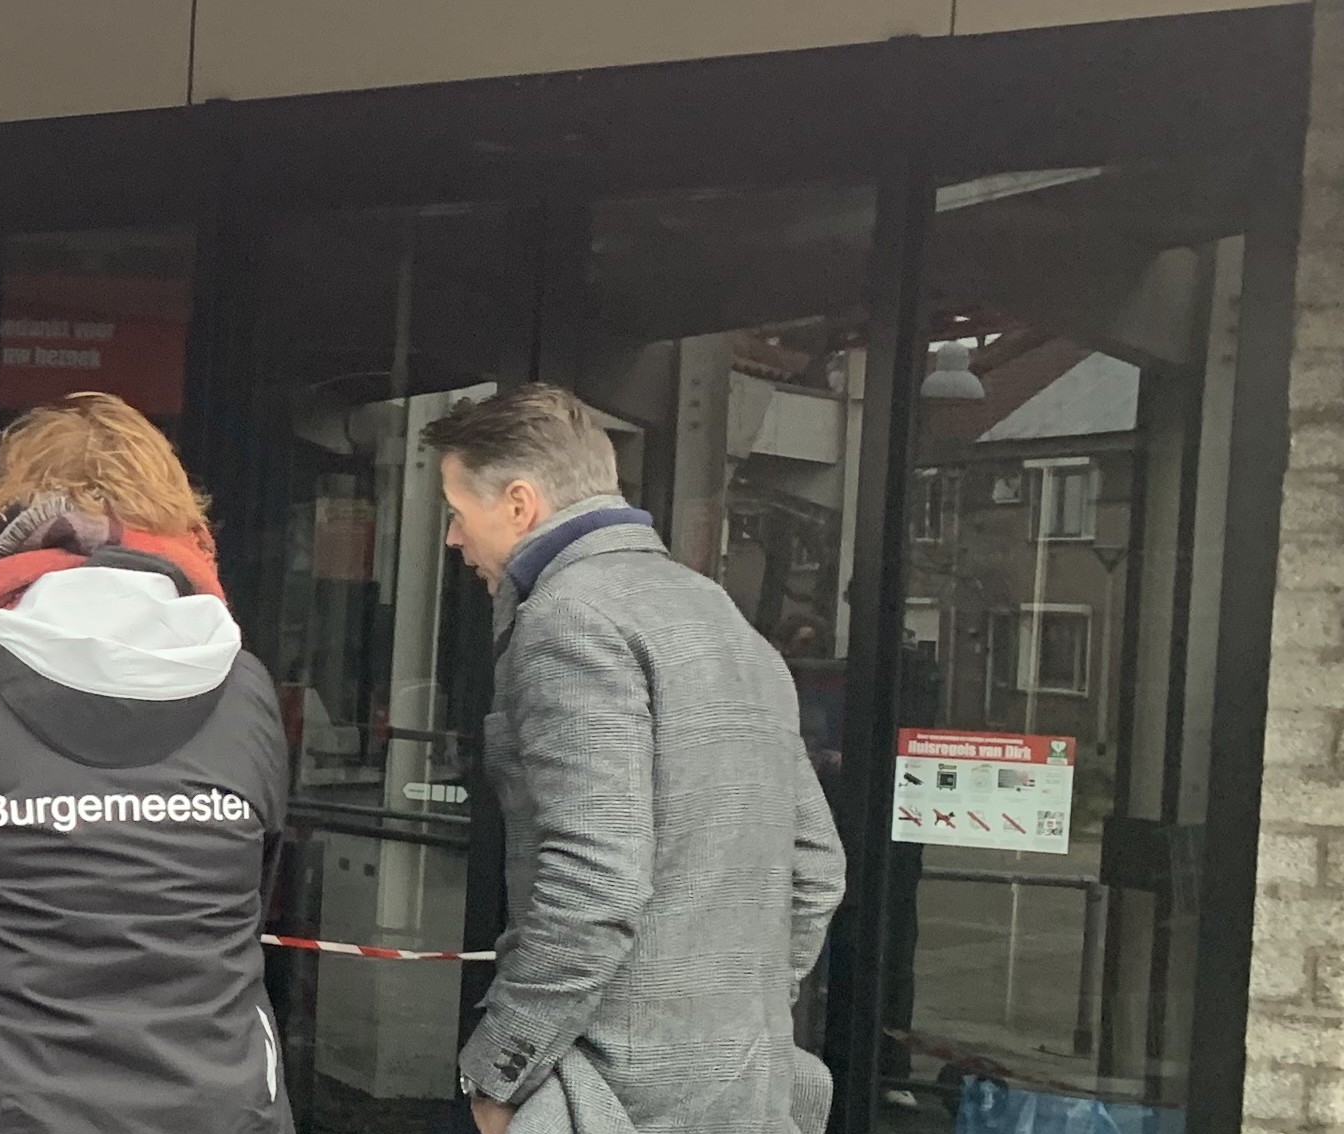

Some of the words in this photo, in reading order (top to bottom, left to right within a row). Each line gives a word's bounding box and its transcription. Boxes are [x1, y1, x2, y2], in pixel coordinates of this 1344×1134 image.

[908, 740, 976, 757] Huisregels
[979, 744, 1003, 758] van
[1005, 744, 1032, 760] Dirk
